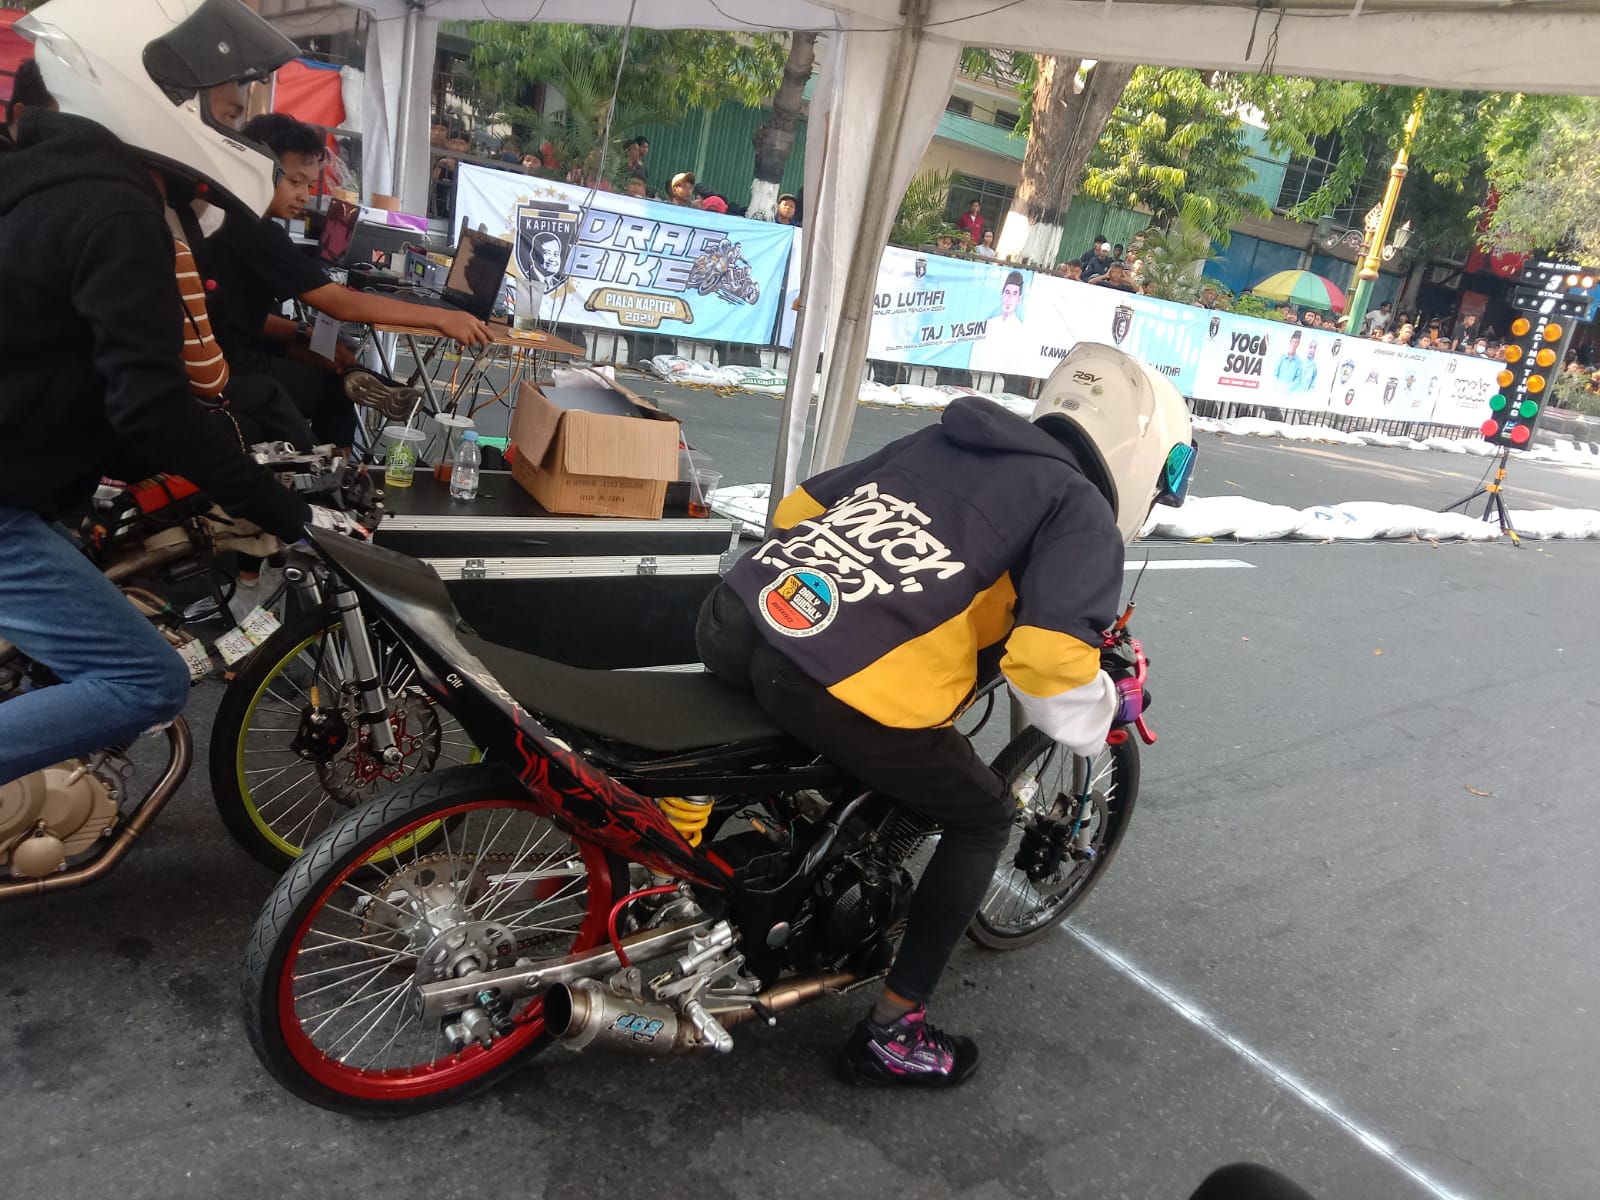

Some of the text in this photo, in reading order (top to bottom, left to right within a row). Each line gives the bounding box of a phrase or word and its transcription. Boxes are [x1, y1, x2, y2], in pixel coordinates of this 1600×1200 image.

[525, 218, 571, 234] KAPITEN
[578, 206, 732, 260] DRAG
[568, 246, 698, 292] BIKE
[604, 291, 677, 316] PIALA KAPITEN
[897, 290, 945, 307] LUTHFI
[1538, 291, 1564, 299] STAGE
[624, 312, 655, 325] 2024
[921, 320, 988, 342] TAJ YASIN
[1526, 316, 1548, 366] RACING
[1223, 354, 1262, 377] SOVA
[1072, 371, 1102, 383] RSV
[1510, 369, 1532, 417] TIMING
[798, 586, 822, 606] DAILY
